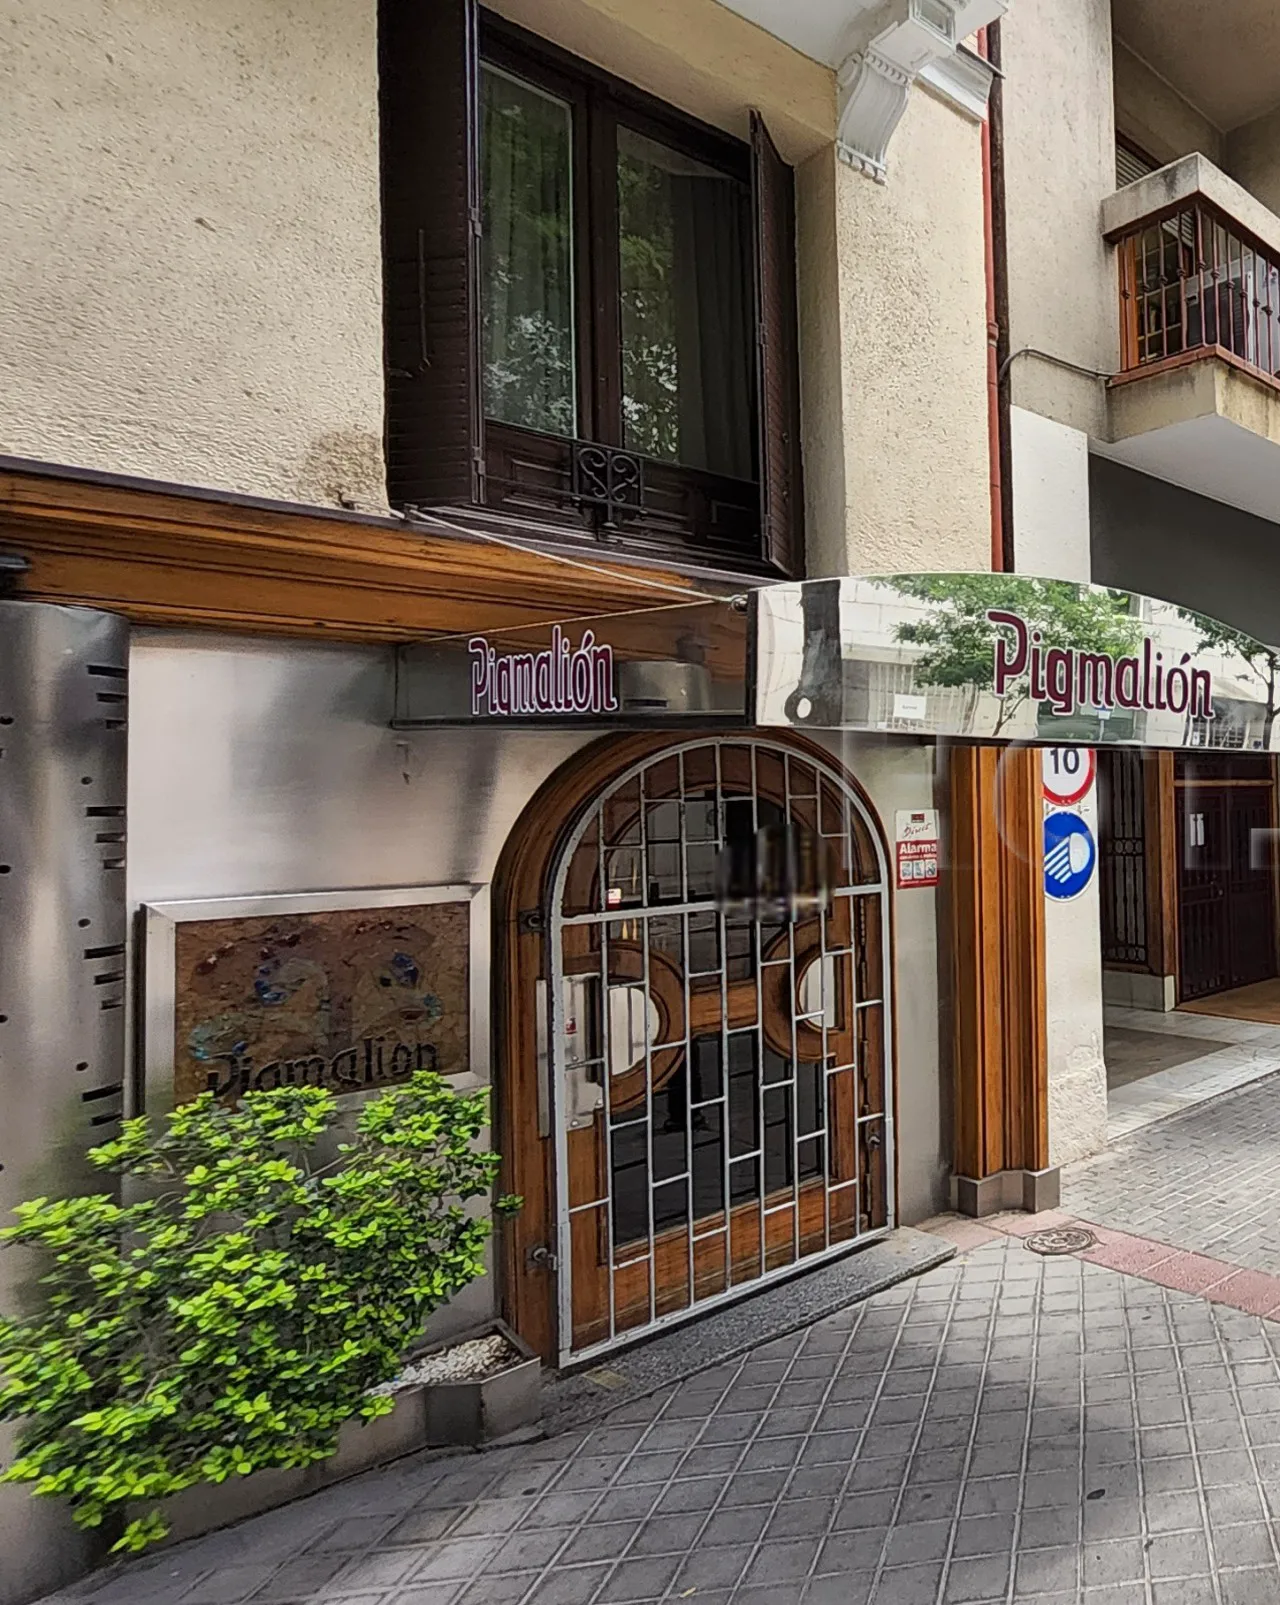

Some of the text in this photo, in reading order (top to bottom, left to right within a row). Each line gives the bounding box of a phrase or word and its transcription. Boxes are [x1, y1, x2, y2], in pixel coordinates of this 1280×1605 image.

[468, 624, 618, 716] Pigmalión
[986, 609, 1216, 718] Pigmalión
[1049, 747, 1080, 775] 10
[899, 843, 938, 855] Alarma
